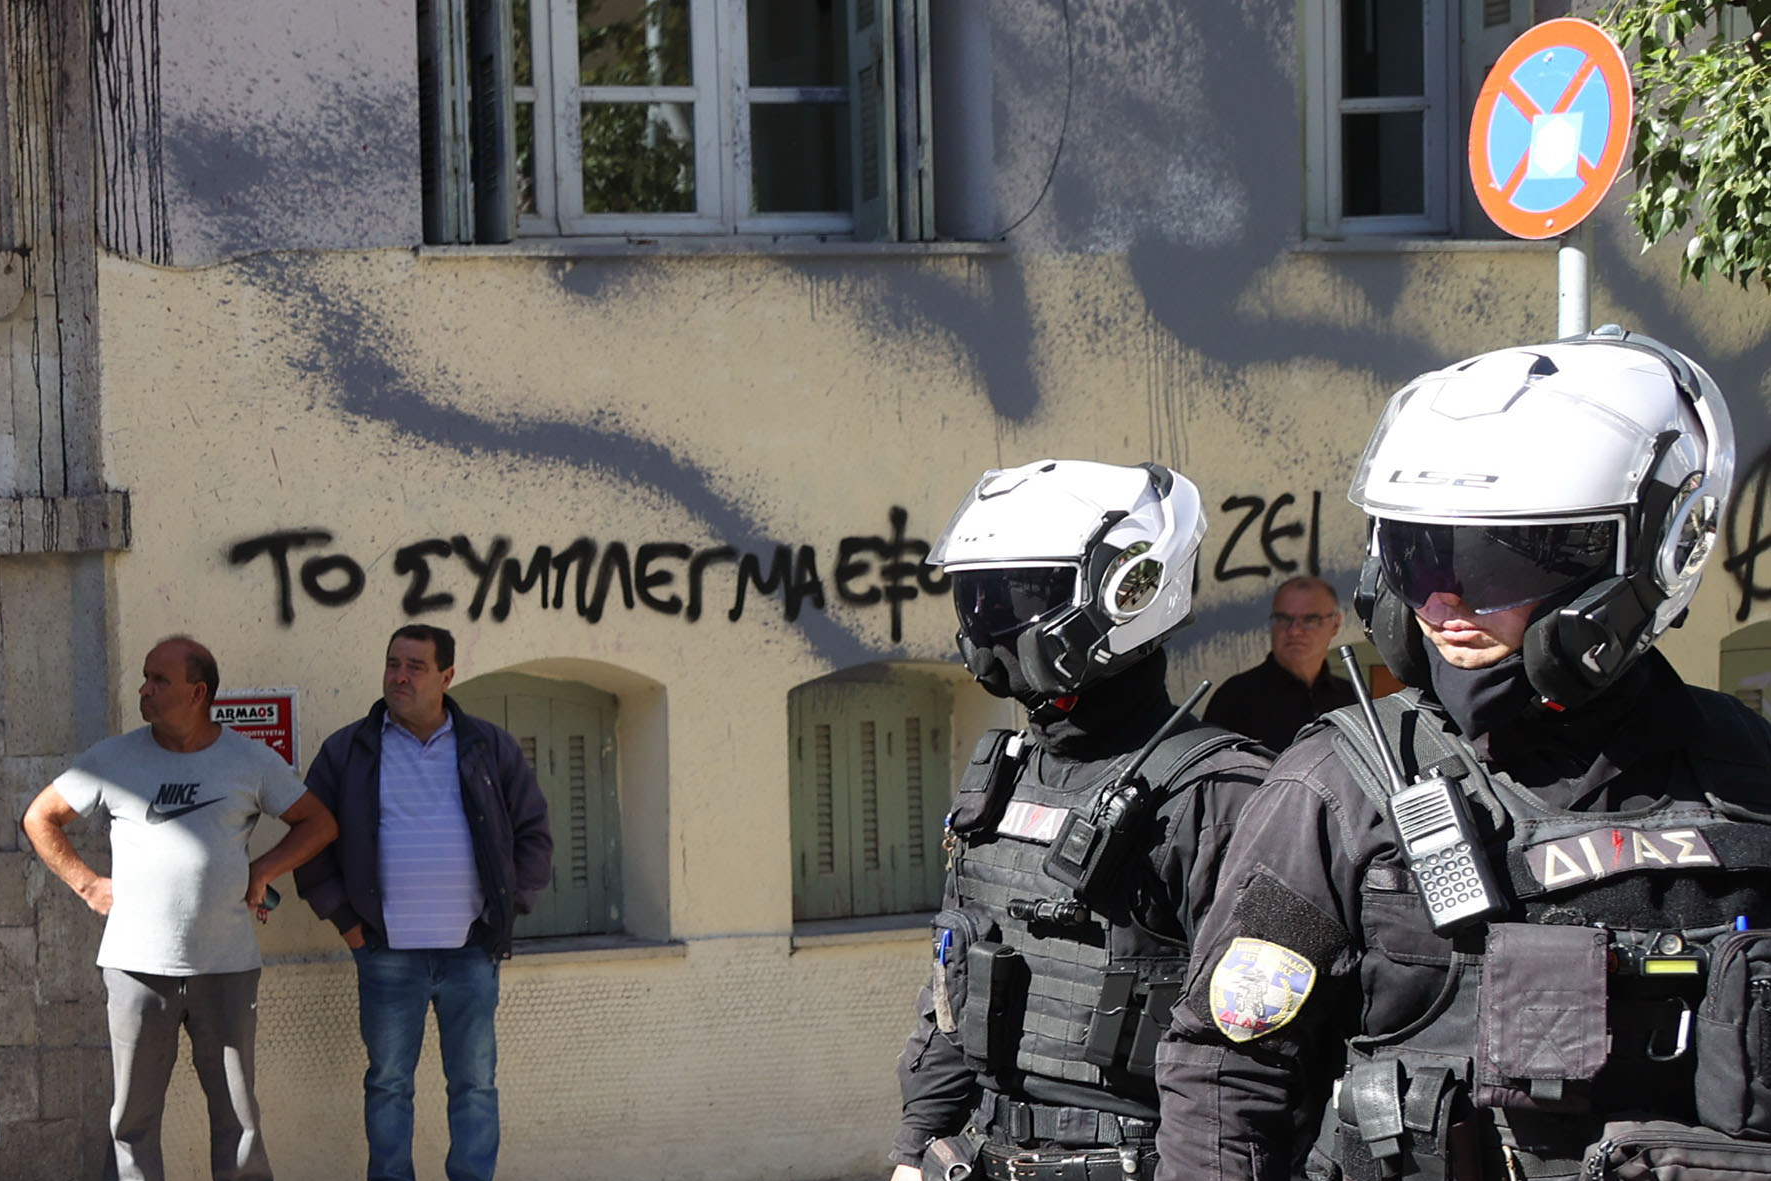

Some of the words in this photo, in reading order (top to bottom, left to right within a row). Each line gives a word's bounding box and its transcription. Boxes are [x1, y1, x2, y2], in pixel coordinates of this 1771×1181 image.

[1388, 470, 1500, 490] LS2
[228, 529, 367, 628] ΤΟ
[215, 706, 275, 720] ARMAOS
[154, 783, 201, 805] NIKE
[997, 802, 1058, 840] ΔΙΑ
[1543, 830, 1713, 886] ΔΙΑΣ
